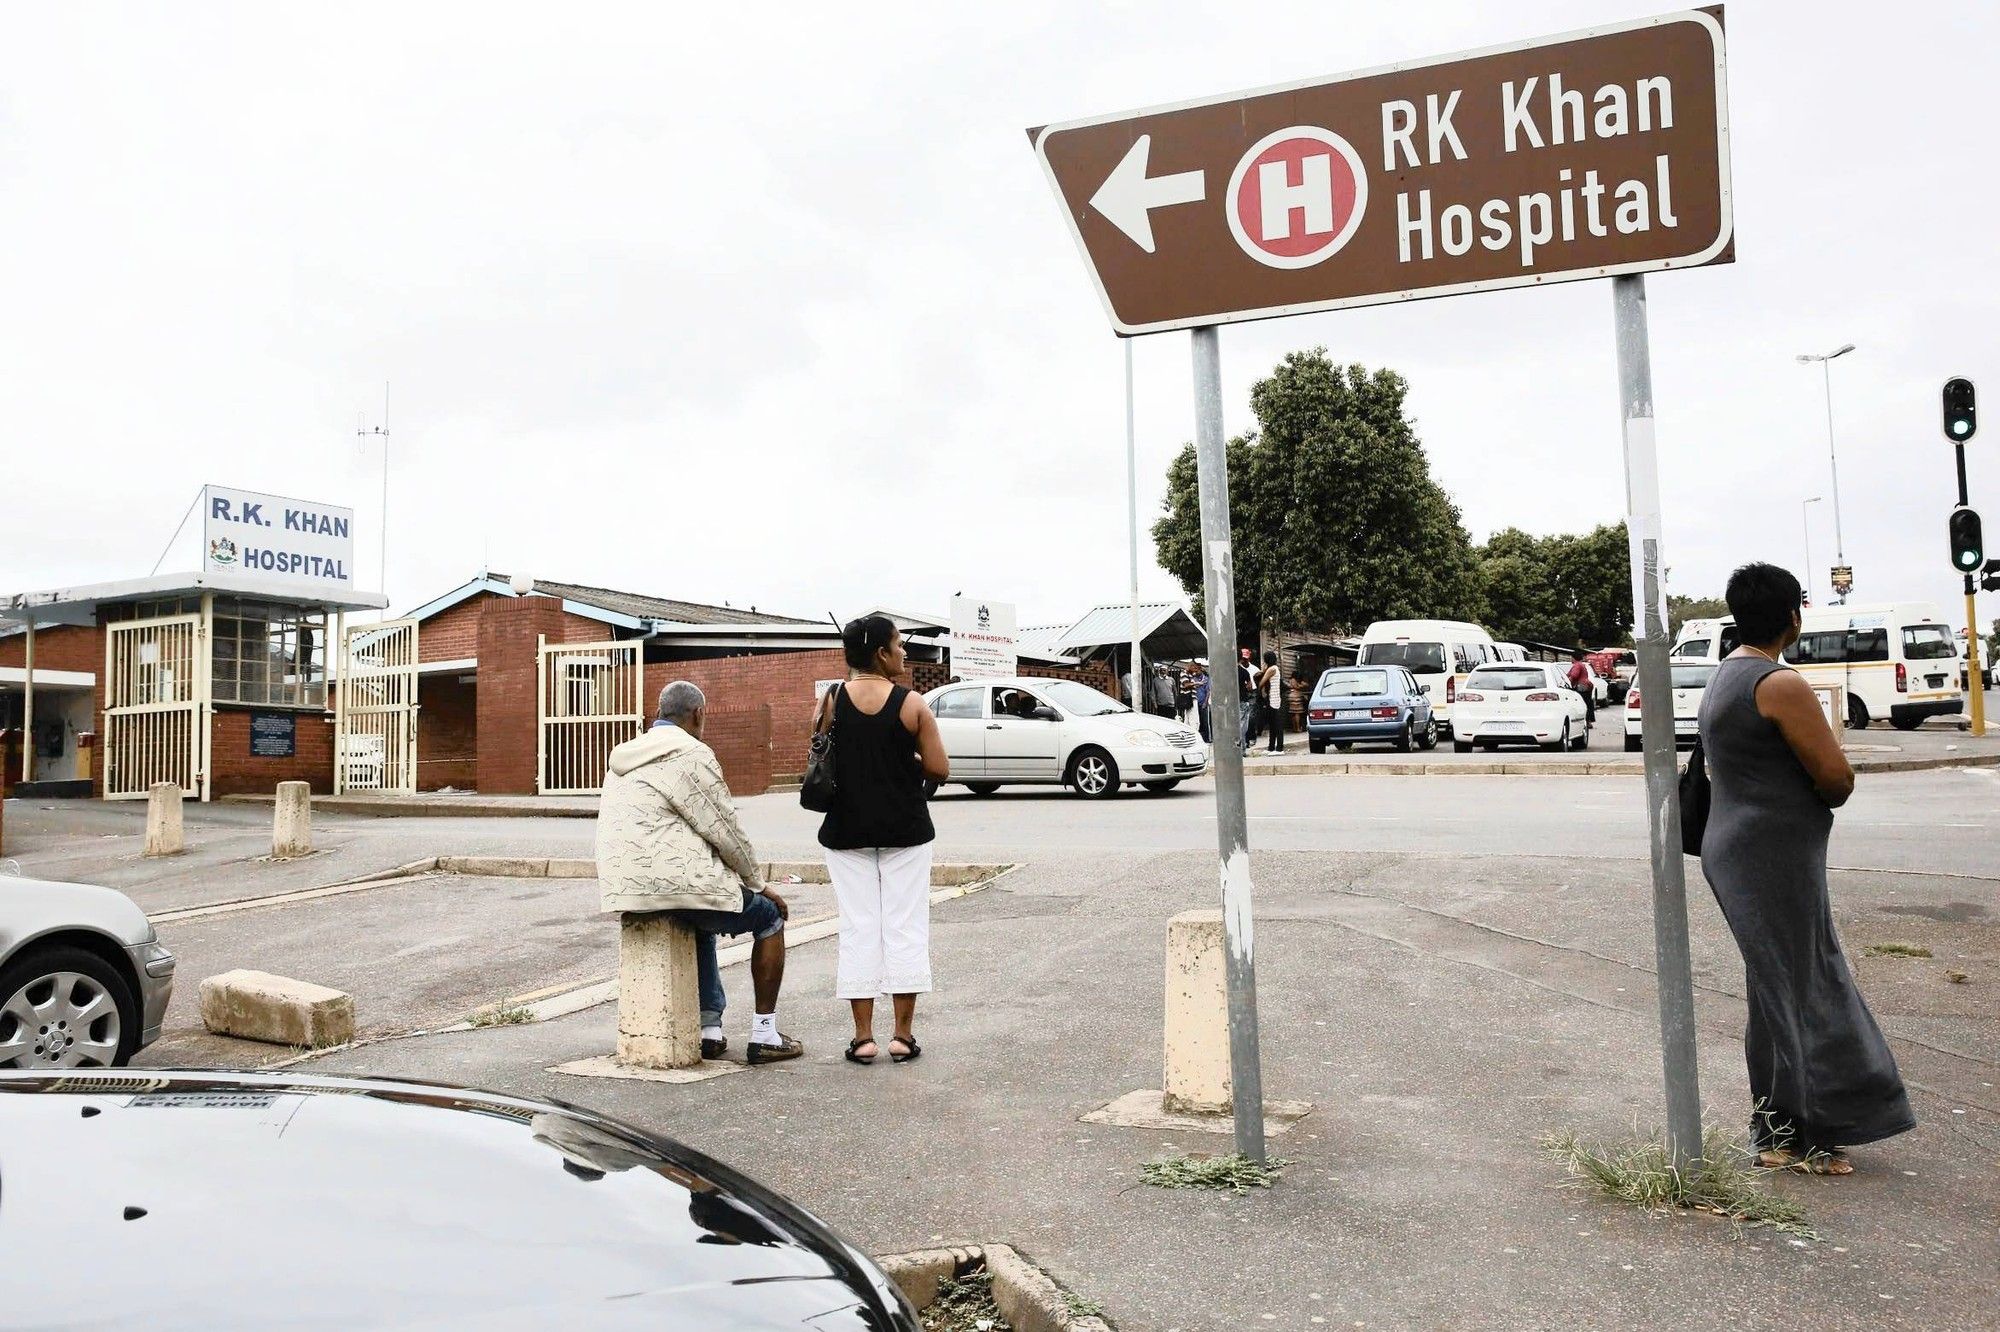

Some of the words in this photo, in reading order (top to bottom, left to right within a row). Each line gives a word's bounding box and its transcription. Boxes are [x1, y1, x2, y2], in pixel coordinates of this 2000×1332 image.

[1381, 89, 1469, 172] RK
[1501, 72, 1673, 153] Khan
[1258, 152, 1334, 242] H
[1396, 155, 1678, 267] Hospital
[212, 497, 271, 527] R.K.
[285, 508, 348, 539] KHAN
[244, 547, 348, 581] HOSPITAL
[968, 633, 985, 641] KHAN
[986, 635, 1013, 644] HOSPITAL
